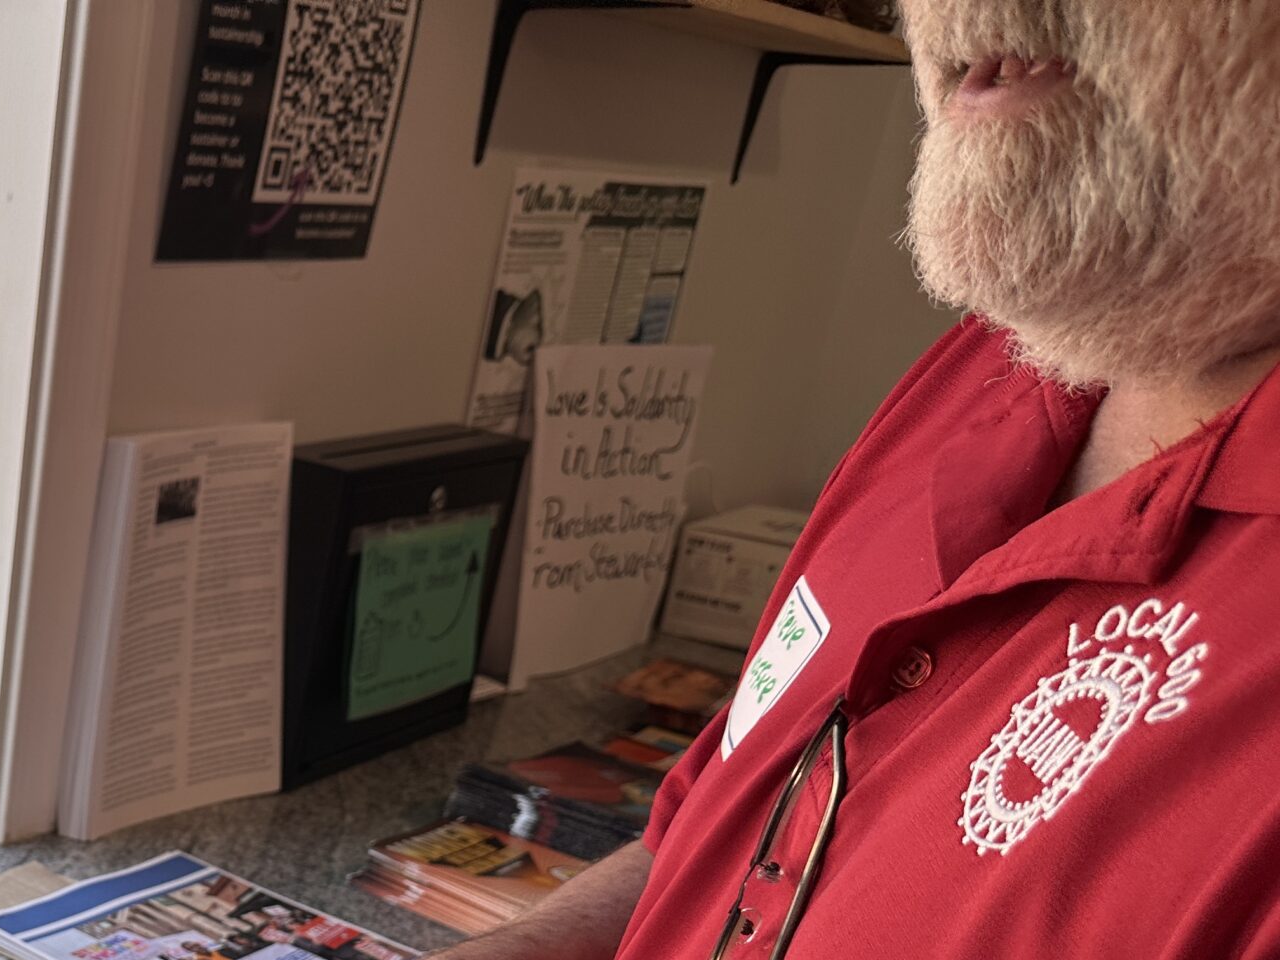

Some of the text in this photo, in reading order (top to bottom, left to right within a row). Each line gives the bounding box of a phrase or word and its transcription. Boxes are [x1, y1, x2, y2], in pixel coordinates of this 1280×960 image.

[546, 368, 588, 417] Love
[1067, 598, 1208, 723] LOCAL 600
[1016, 710, 1087, 784] UAW
